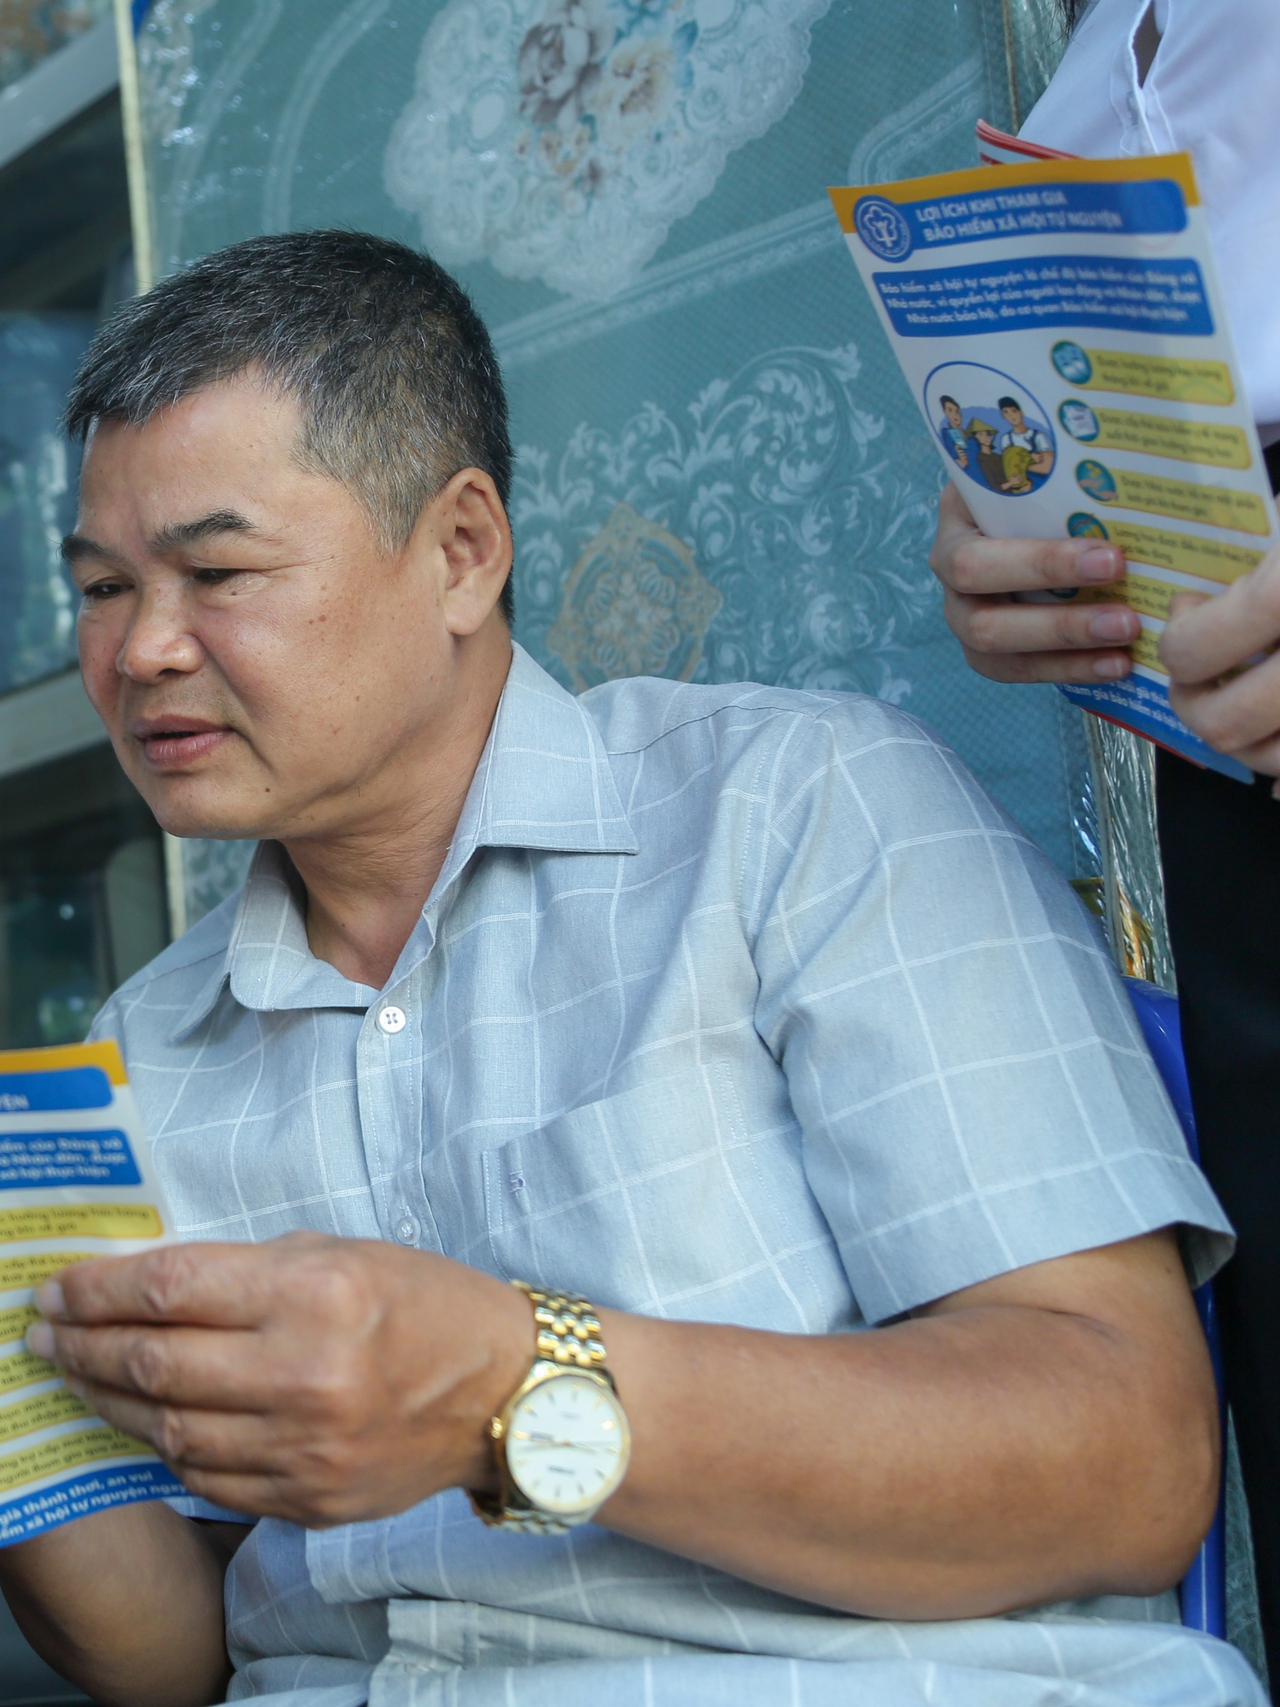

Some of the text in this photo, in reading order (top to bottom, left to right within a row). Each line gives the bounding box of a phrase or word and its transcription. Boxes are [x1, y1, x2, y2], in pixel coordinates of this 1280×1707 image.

[915, 190, 1068, 222] LỢI ÍCH KHI THAM GIA
[923, 221, 956, 242] BẢO
[956, 217, 996, 239] HIỂM
[996, 213, 1019, 231] XÃ
[1019, 211, 1046, 231] HỘI
[1047, 211, 1067, 228] TỰ
[1067, 209, 1123, 230] NGUYỆN
[21, 1491, 68, 1515] thảnh
[67, 1480, 106, 1501] thơi,
[107, 1475, 127, 1488] an
[128, 1470, 154, 1485] vui
[26, 1515, 45, 1532] xã
[45, 1506, 71, 1524] hội
[71, 1499, 90, 1515] tự
[90, 1486, 148, 1508] nguyện
